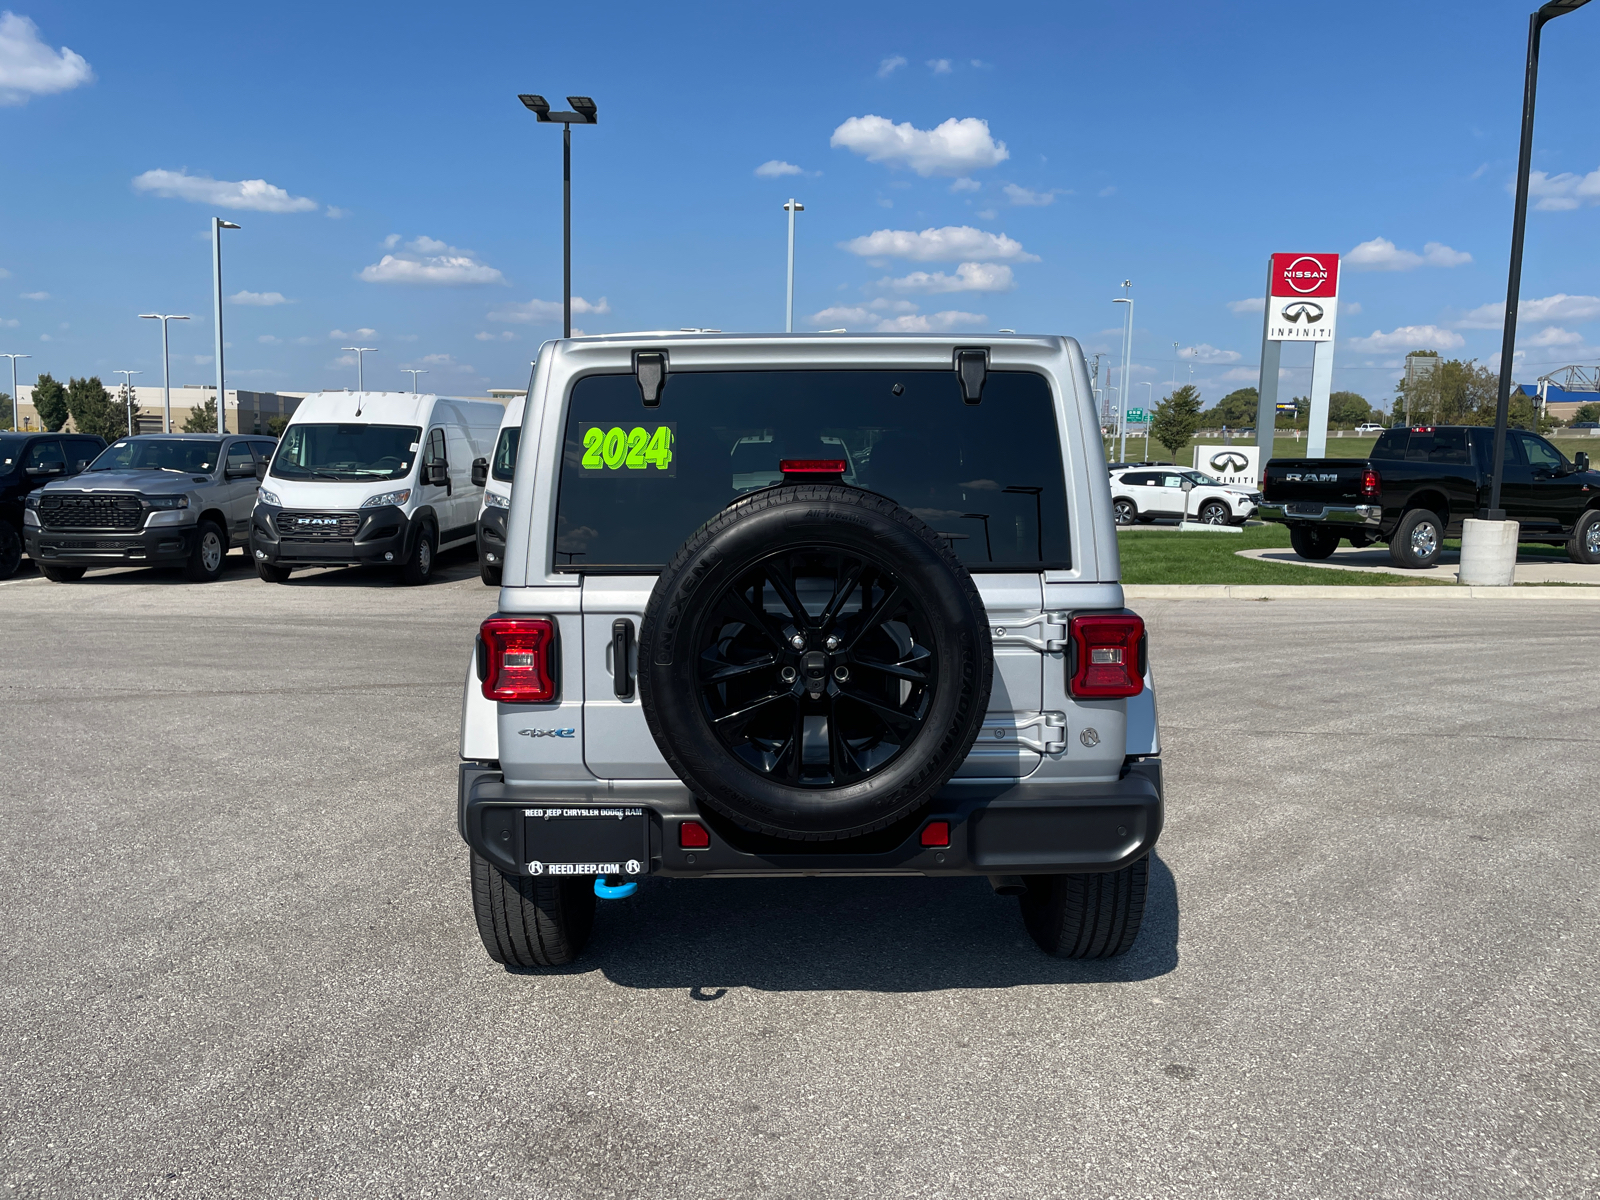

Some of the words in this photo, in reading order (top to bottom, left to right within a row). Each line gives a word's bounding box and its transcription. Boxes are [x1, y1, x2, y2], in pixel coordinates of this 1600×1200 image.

[1283, 271, 1328, 279] NISSAN
[1271, 328, 1332, 337] INFINITI
[581, 426, 673, 470] 2024
[1211, 476, 1254, 484] FINITI
[1285, 473, 1338, 483] RAM
[61, 499, 112, 508] RAM
[805, 509, 871, 527] All-Weather
[659, 558, 711, 651] NEXEN
[940, 643, 975, 755] ROADIAN
[886, 753, 942, 807] HTX2
[718, 784, 774, 815] 255/60R20
[525, 809, 543, 817] REED
[545, 809, 562, 817] JEEP
[563, 809, 599, 817] CHRYSLER
[600, 808, 624, 816] DODGE
[625, 808, 643, 816] RAM
[548, 863, 620, 875] REEDJEEP.COM
